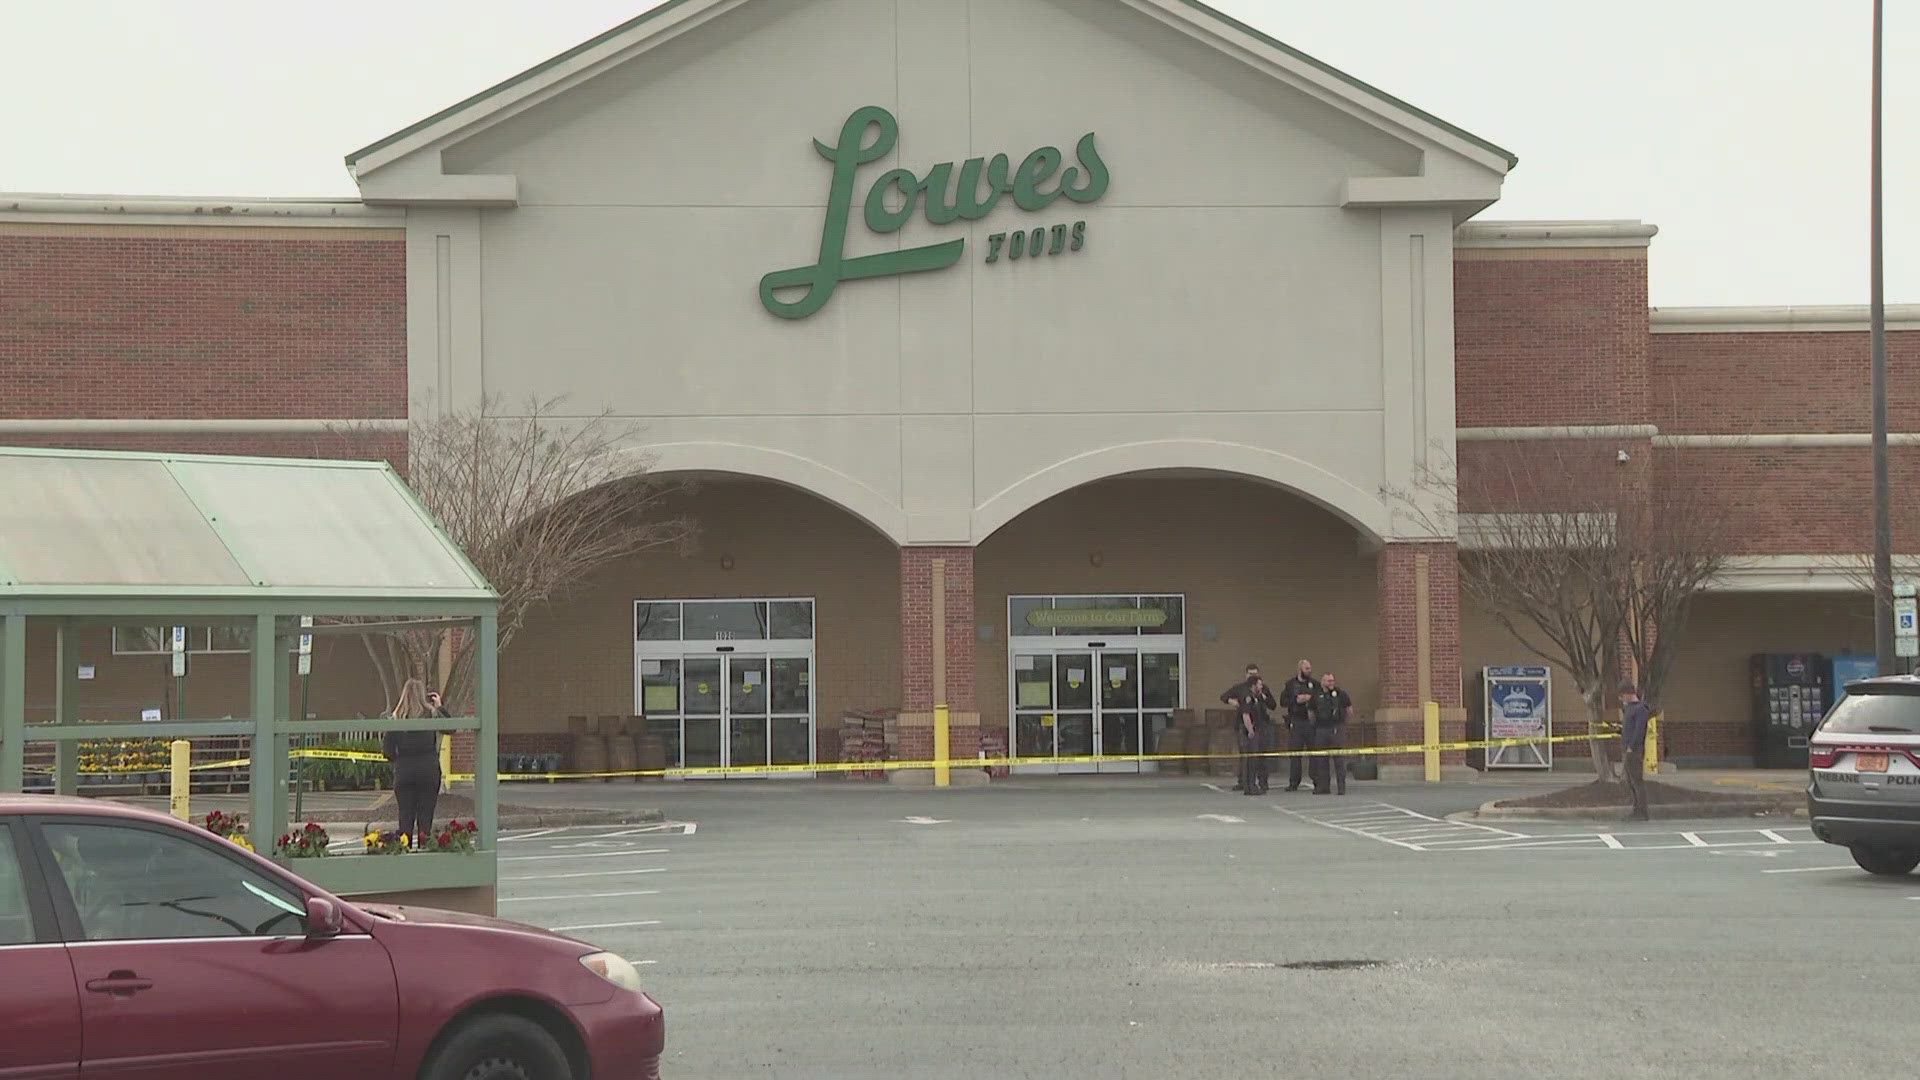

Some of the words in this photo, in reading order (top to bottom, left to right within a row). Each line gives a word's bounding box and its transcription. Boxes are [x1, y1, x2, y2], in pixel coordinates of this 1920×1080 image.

[759, 105, 1109, 320] Lowes
[985, 221, 1086, 264] FOODS
[1035, 611, 1087, 622] Welcome
[1091, 612, 1100, 622] to
[1105, 610, 1126, 622] Our
[1130, 611, 1159, 622] Farm
[1818, 773, 1860, 784] MEBANE
